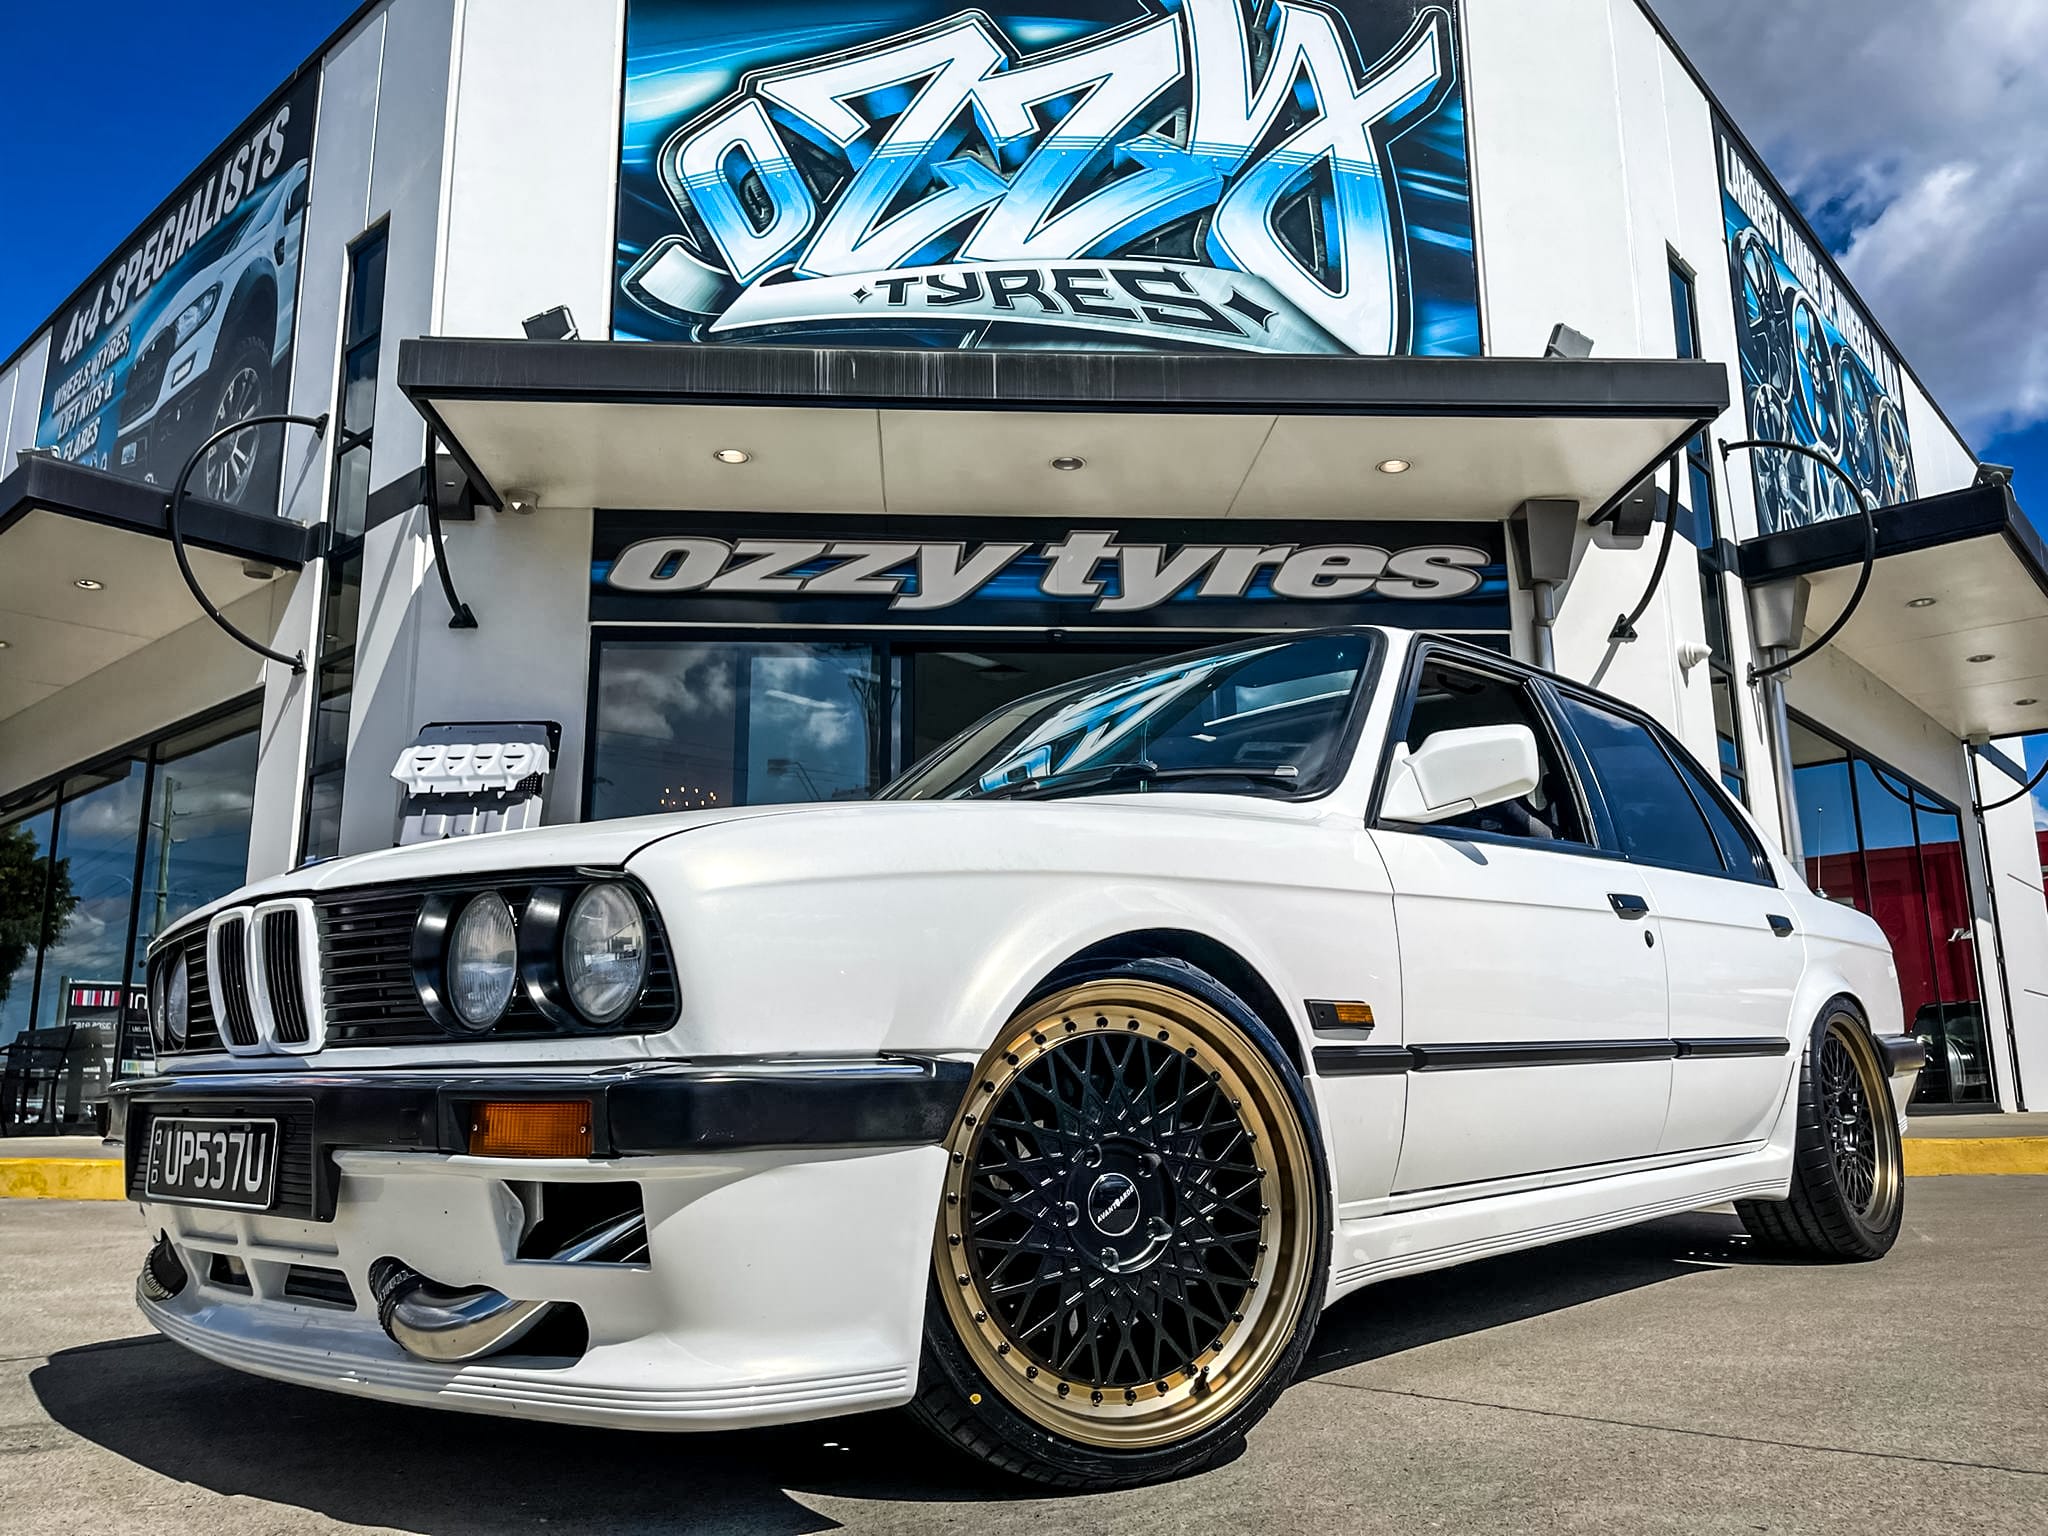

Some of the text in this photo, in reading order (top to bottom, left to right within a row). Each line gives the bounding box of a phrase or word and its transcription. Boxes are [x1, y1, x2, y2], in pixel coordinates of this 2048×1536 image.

[676, 0, 1446, 357] OZZY
[105, 105, 290, 324] SPECIALISTS
[1720, 134, 1780, 255] LARGEST
[1779, 211, 1820, 305] RANGE
[1818, 264, 1835, 326] OF
[1833, 282, 1875, 375] WHEELS
[871, 268, 1248, 337] TYRES
[58, 371, 115, 440] LIFT KITS &
[63, 416, 100, 462] FLARES
[606, 529, 1491, 612] ozzy tyres
[150, 1129, 163, 1184] QLD
[164, 1130, 267, 1192] UP537U
